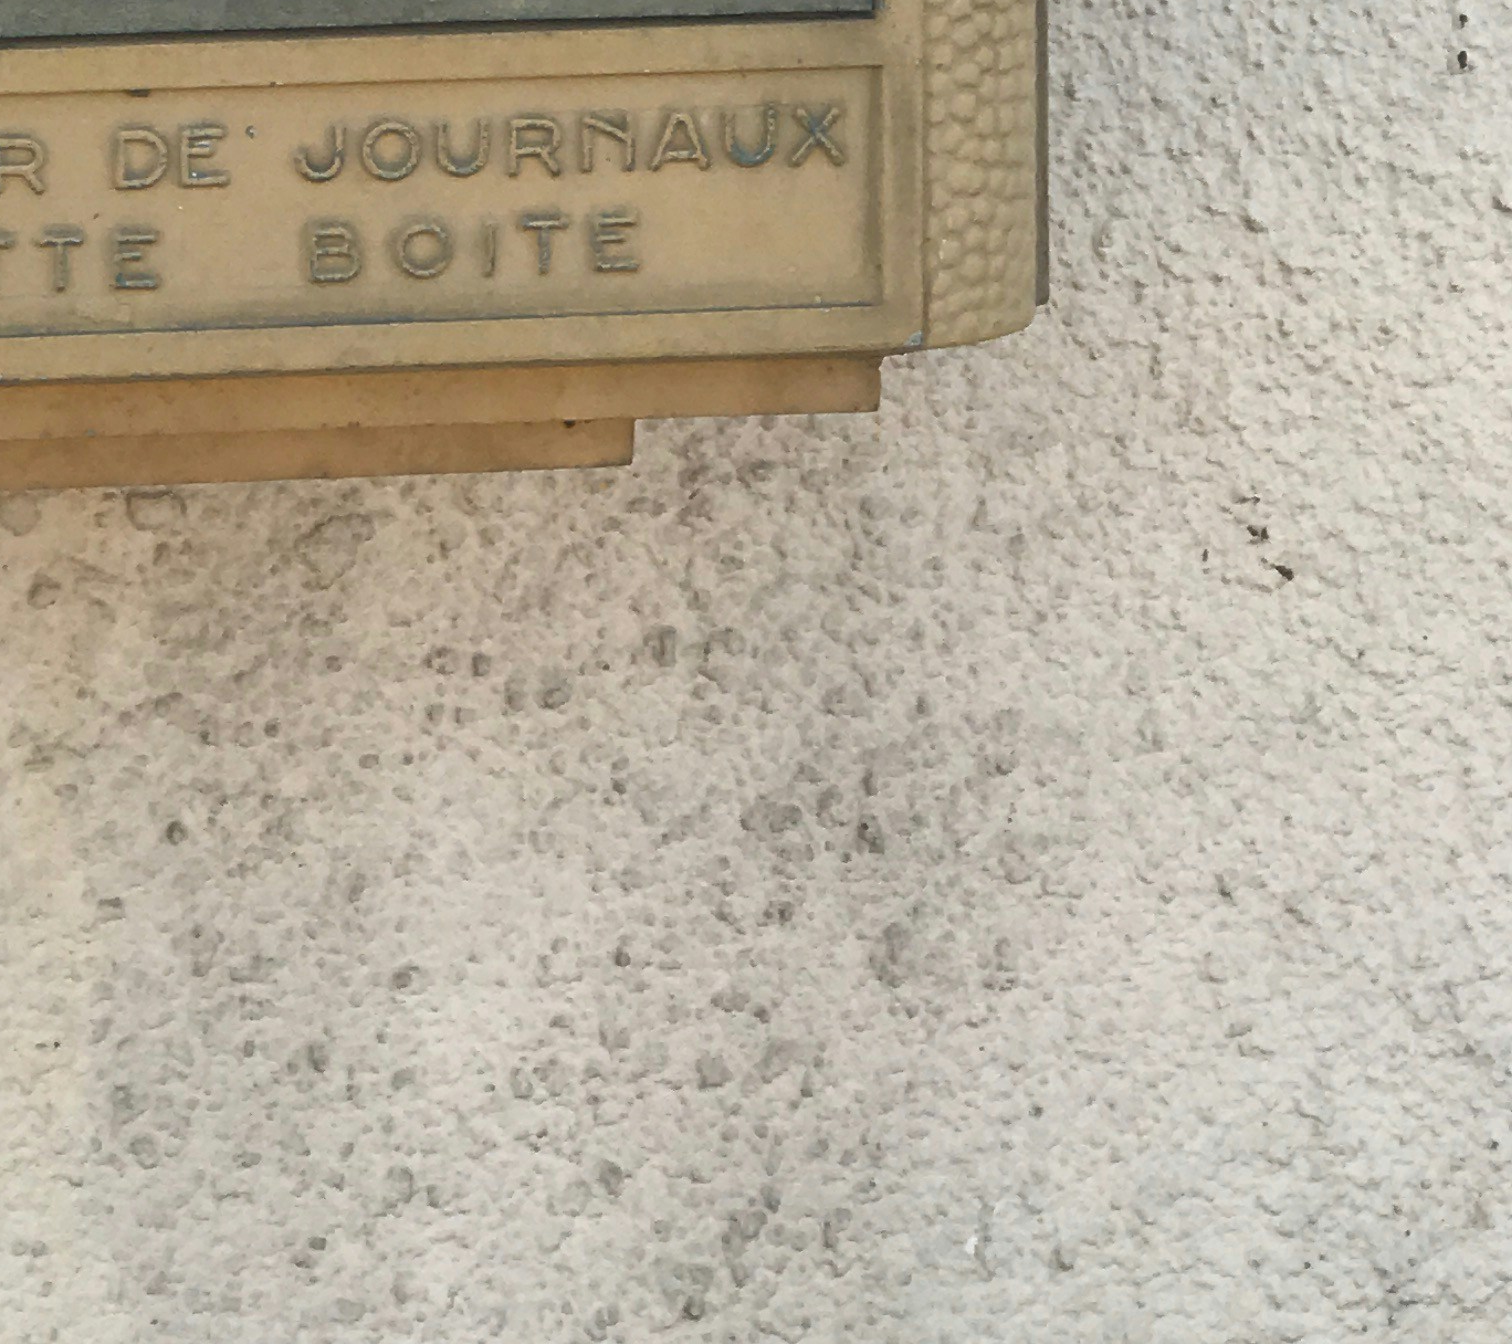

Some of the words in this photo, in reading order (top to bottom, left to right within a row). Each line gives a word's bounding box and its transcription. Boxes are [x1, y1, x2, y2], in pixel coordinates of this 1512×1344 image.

[112, 122, 230, 191] DE
[294, 104, 847, 184] JOURNAUX
[308, 205, 641, 285] BOITE
